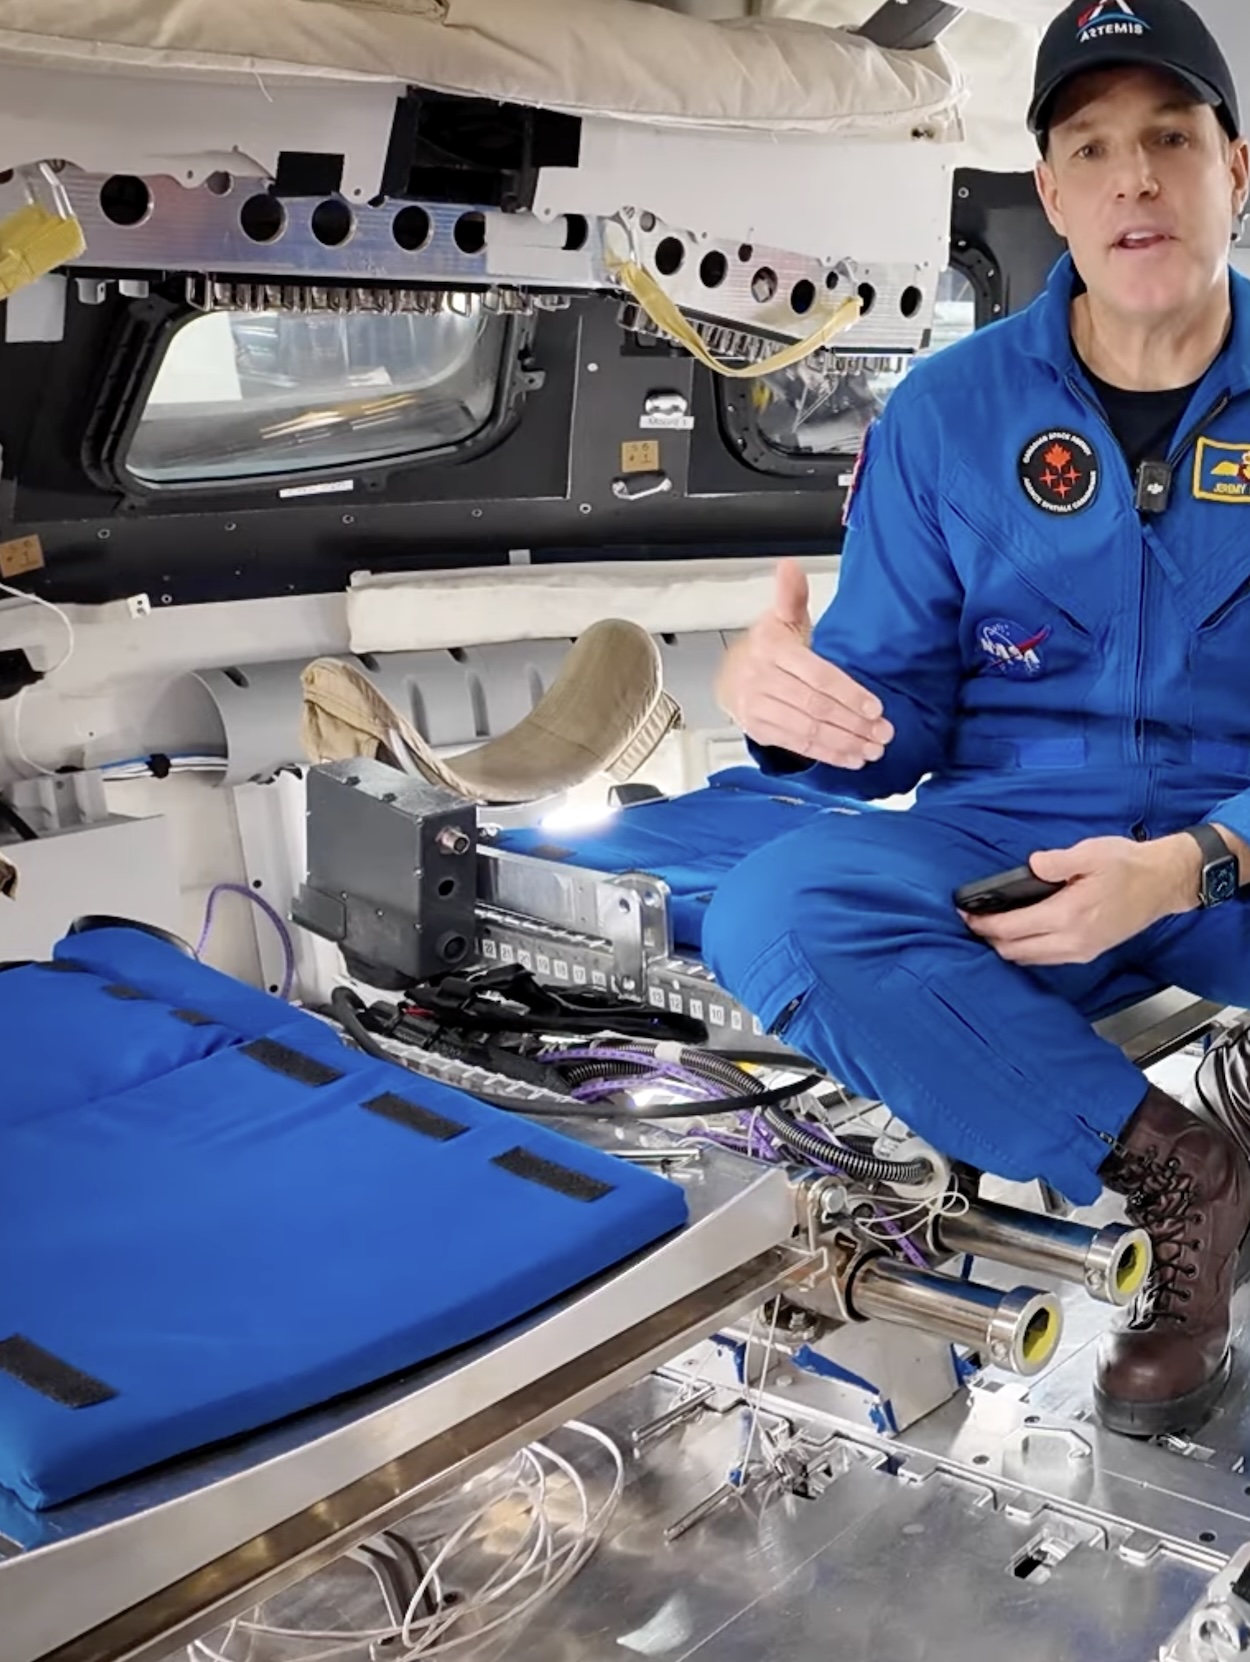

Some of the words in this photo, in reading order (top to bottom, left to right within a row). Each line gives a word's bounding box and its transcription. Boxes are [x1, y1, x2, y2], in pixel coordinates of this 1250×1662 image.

[1080, 22, 1144, 43] ARTEMIS
[1213, 482, 1247, 495] JEREMY
[981, 637, 1041, 665] NASA
[692, 1003, 701, 1014] 11
[711, 1008, 722, 1020] 10
